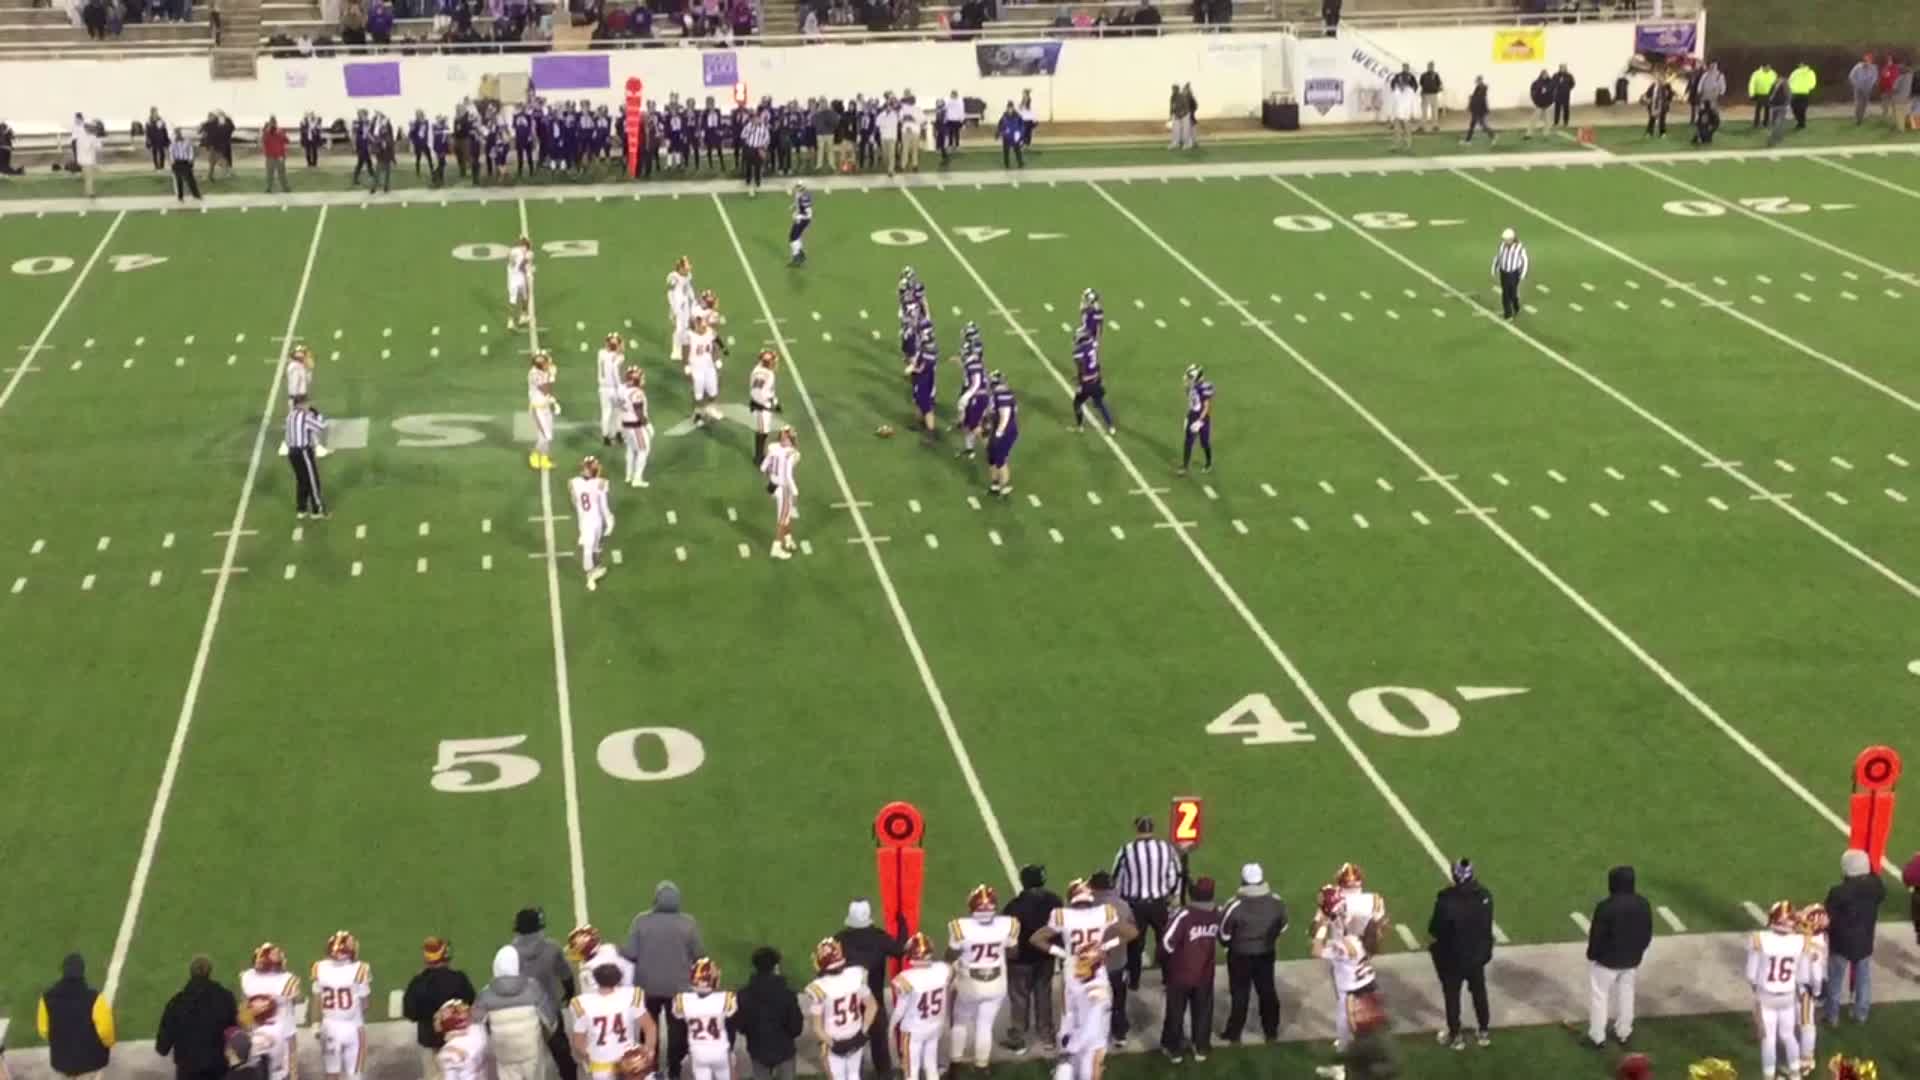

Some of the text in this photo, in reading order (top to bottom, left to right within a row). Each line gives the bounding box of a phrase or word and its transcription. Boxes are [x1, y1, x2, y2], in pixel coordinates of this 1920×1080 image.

[580, 492, 592, 512] 8
[1177, 802, 1198, 838] 2
[971, 943, 1000, 963] 75
[1768, 955, 1794, 982] 16
[322, 986, 352, 1010] 20
[834, 993, 860, 1026] 54
[917, 988, 944, 1019] 45
[593, 1013, 627, 1046] 74
[689, 1018, 721, 1041] 24
